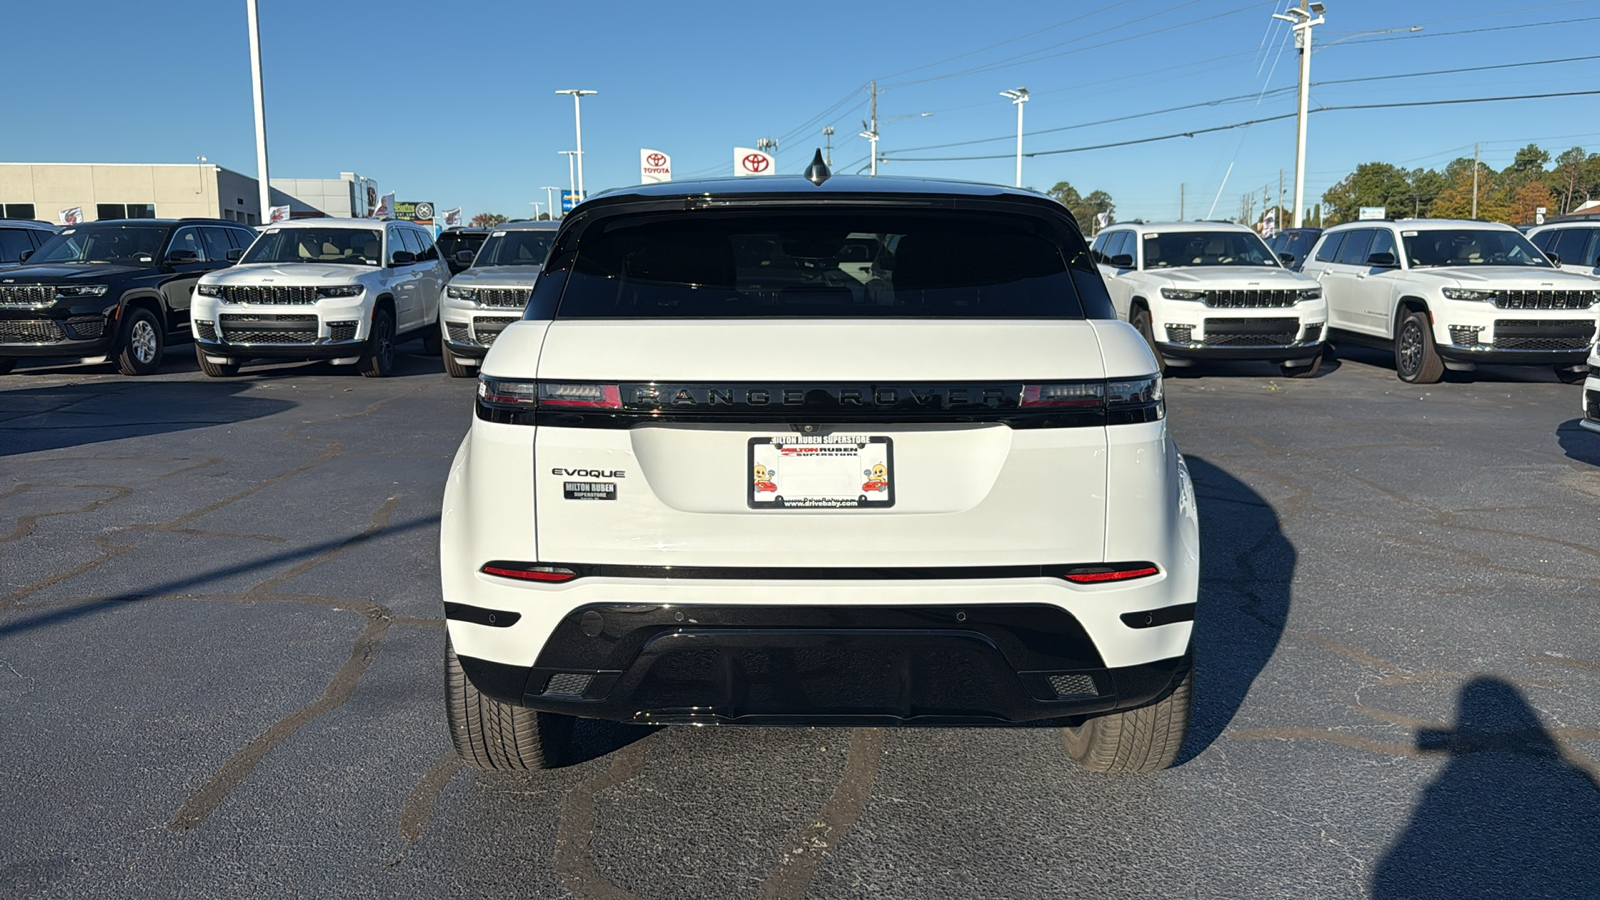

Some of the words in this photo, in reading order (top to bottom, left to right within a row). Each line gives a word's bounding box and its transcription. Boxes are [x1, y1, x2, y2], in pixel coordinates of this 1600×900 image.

[637, 388, 804, 405] RANGE
[838, 388, 1005, 405] ROVER
[798, 436, 822, 444] RUBEN
[823, 436, 870, 444] SUPERSTORE
[551, 468, 626, 479] EVOQUE
[565, 483, 590, 491] MILTON
[591, 483, 614, 492] RUBEN
